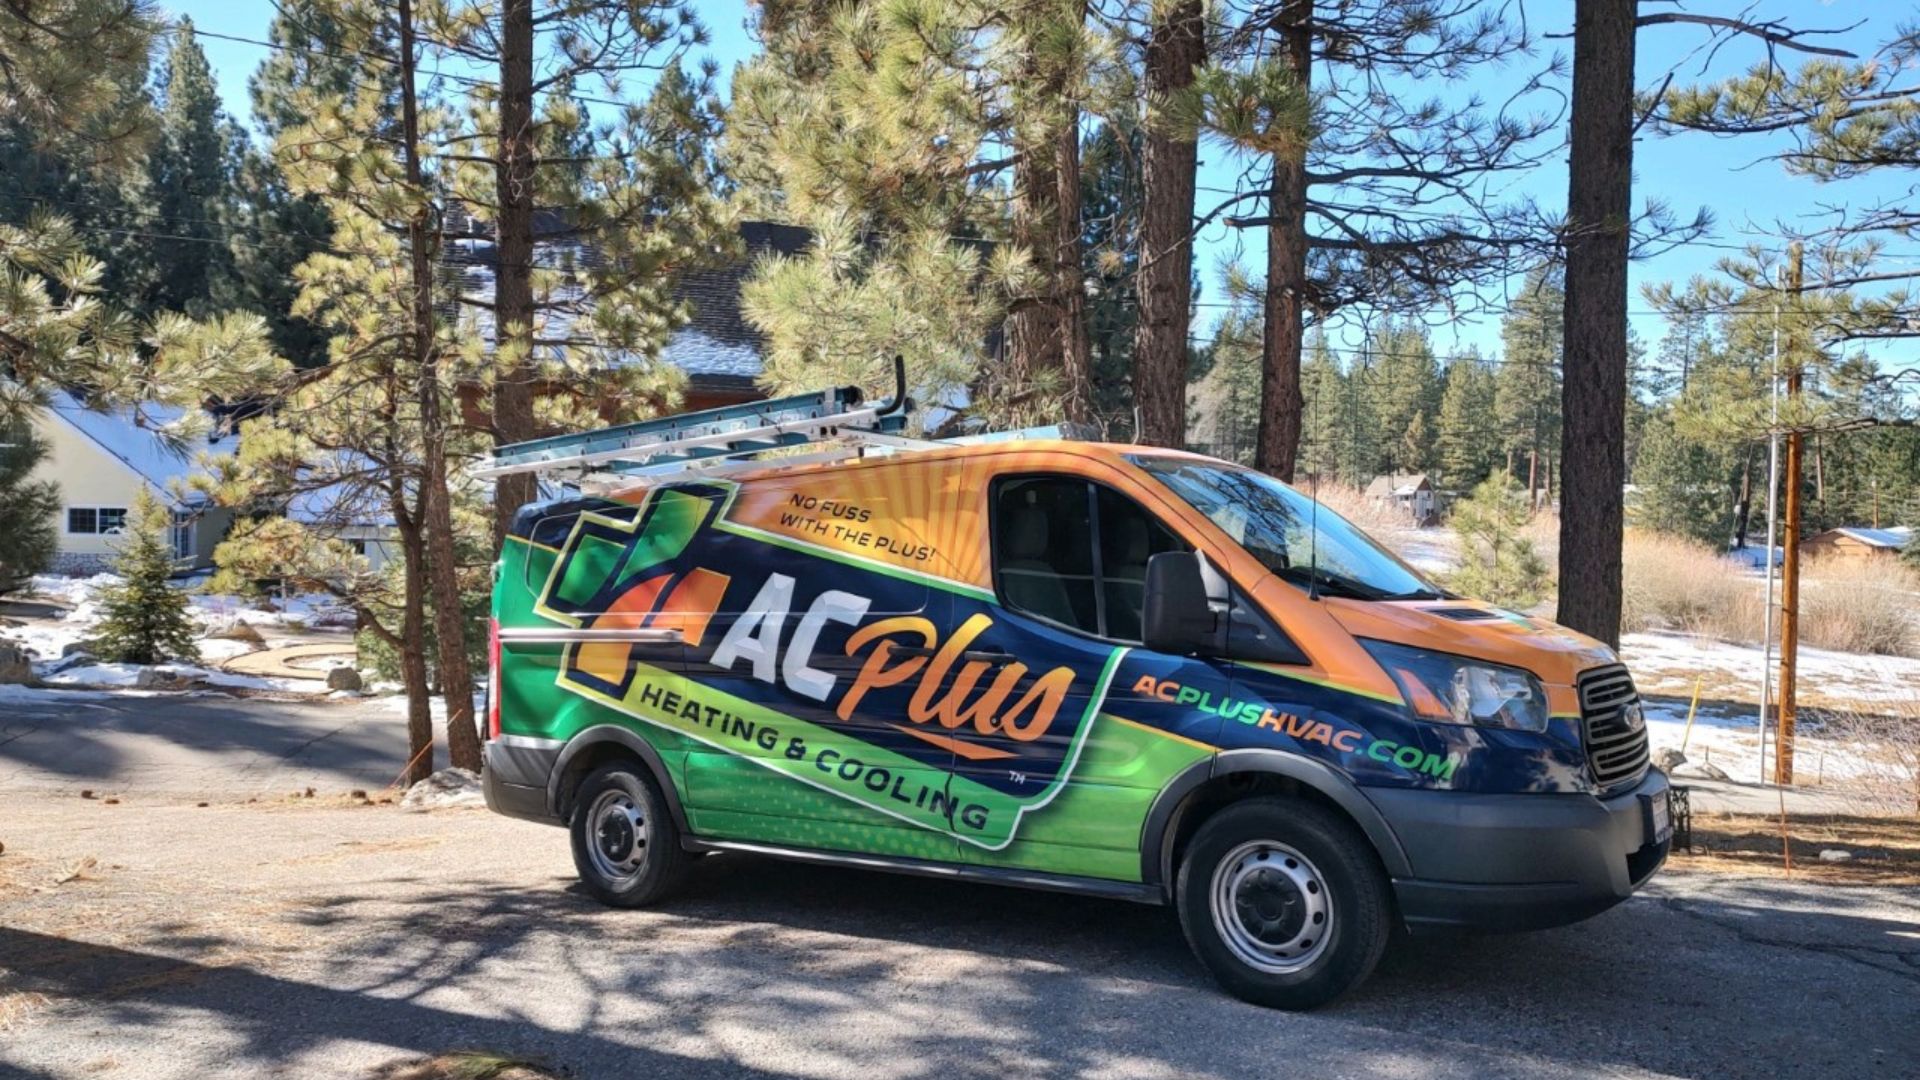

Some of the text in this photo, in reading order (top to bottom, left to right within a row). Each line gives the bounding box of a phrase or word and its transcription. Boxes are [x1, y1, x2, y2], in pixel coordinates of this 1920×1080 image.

[780, 512, 936, 562] WITH THE PLUS!
[790, 493, 872, 523] NO FUSS
[640, 683, 990, 830] HEATING & COOLING
[1132, 675, 1459, 780] ACPLUSHVAC.COM
